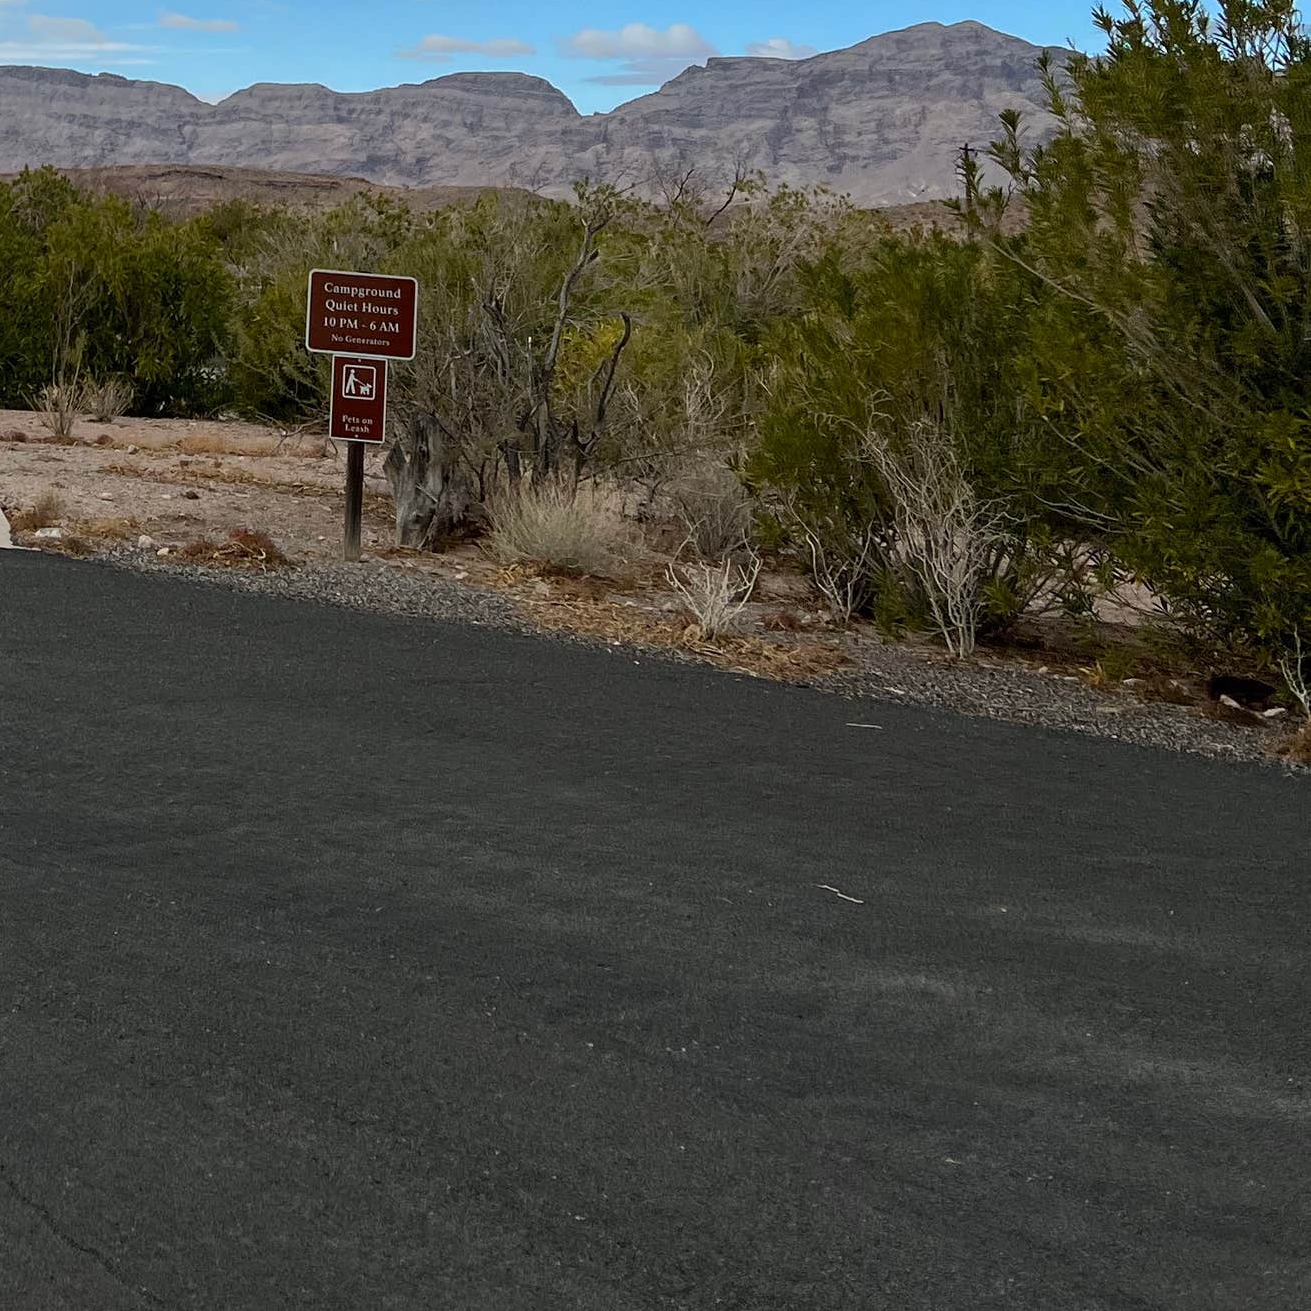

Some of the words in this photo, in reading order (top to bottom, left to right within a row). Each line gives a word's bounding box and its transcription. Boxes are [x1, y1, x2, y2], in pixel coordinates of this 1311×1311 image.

[324, 282, 402, 299] Campground
[325, 299, 358, 312] Quiet
[362, 302, 399, 316] Hours
[323, 316, 336, 327] 10
[339, 318, 358, 329] PM
[369, 321, 377, 331] 6
[379, 321, 400, 333] AM
[331, 333, 344, 342] No
[345, 335, 391, 346] Generators
[342, 415, 360, 424] Pets
[362, 417, 373, 425] on
[345, 423, 370, 433] Leash
